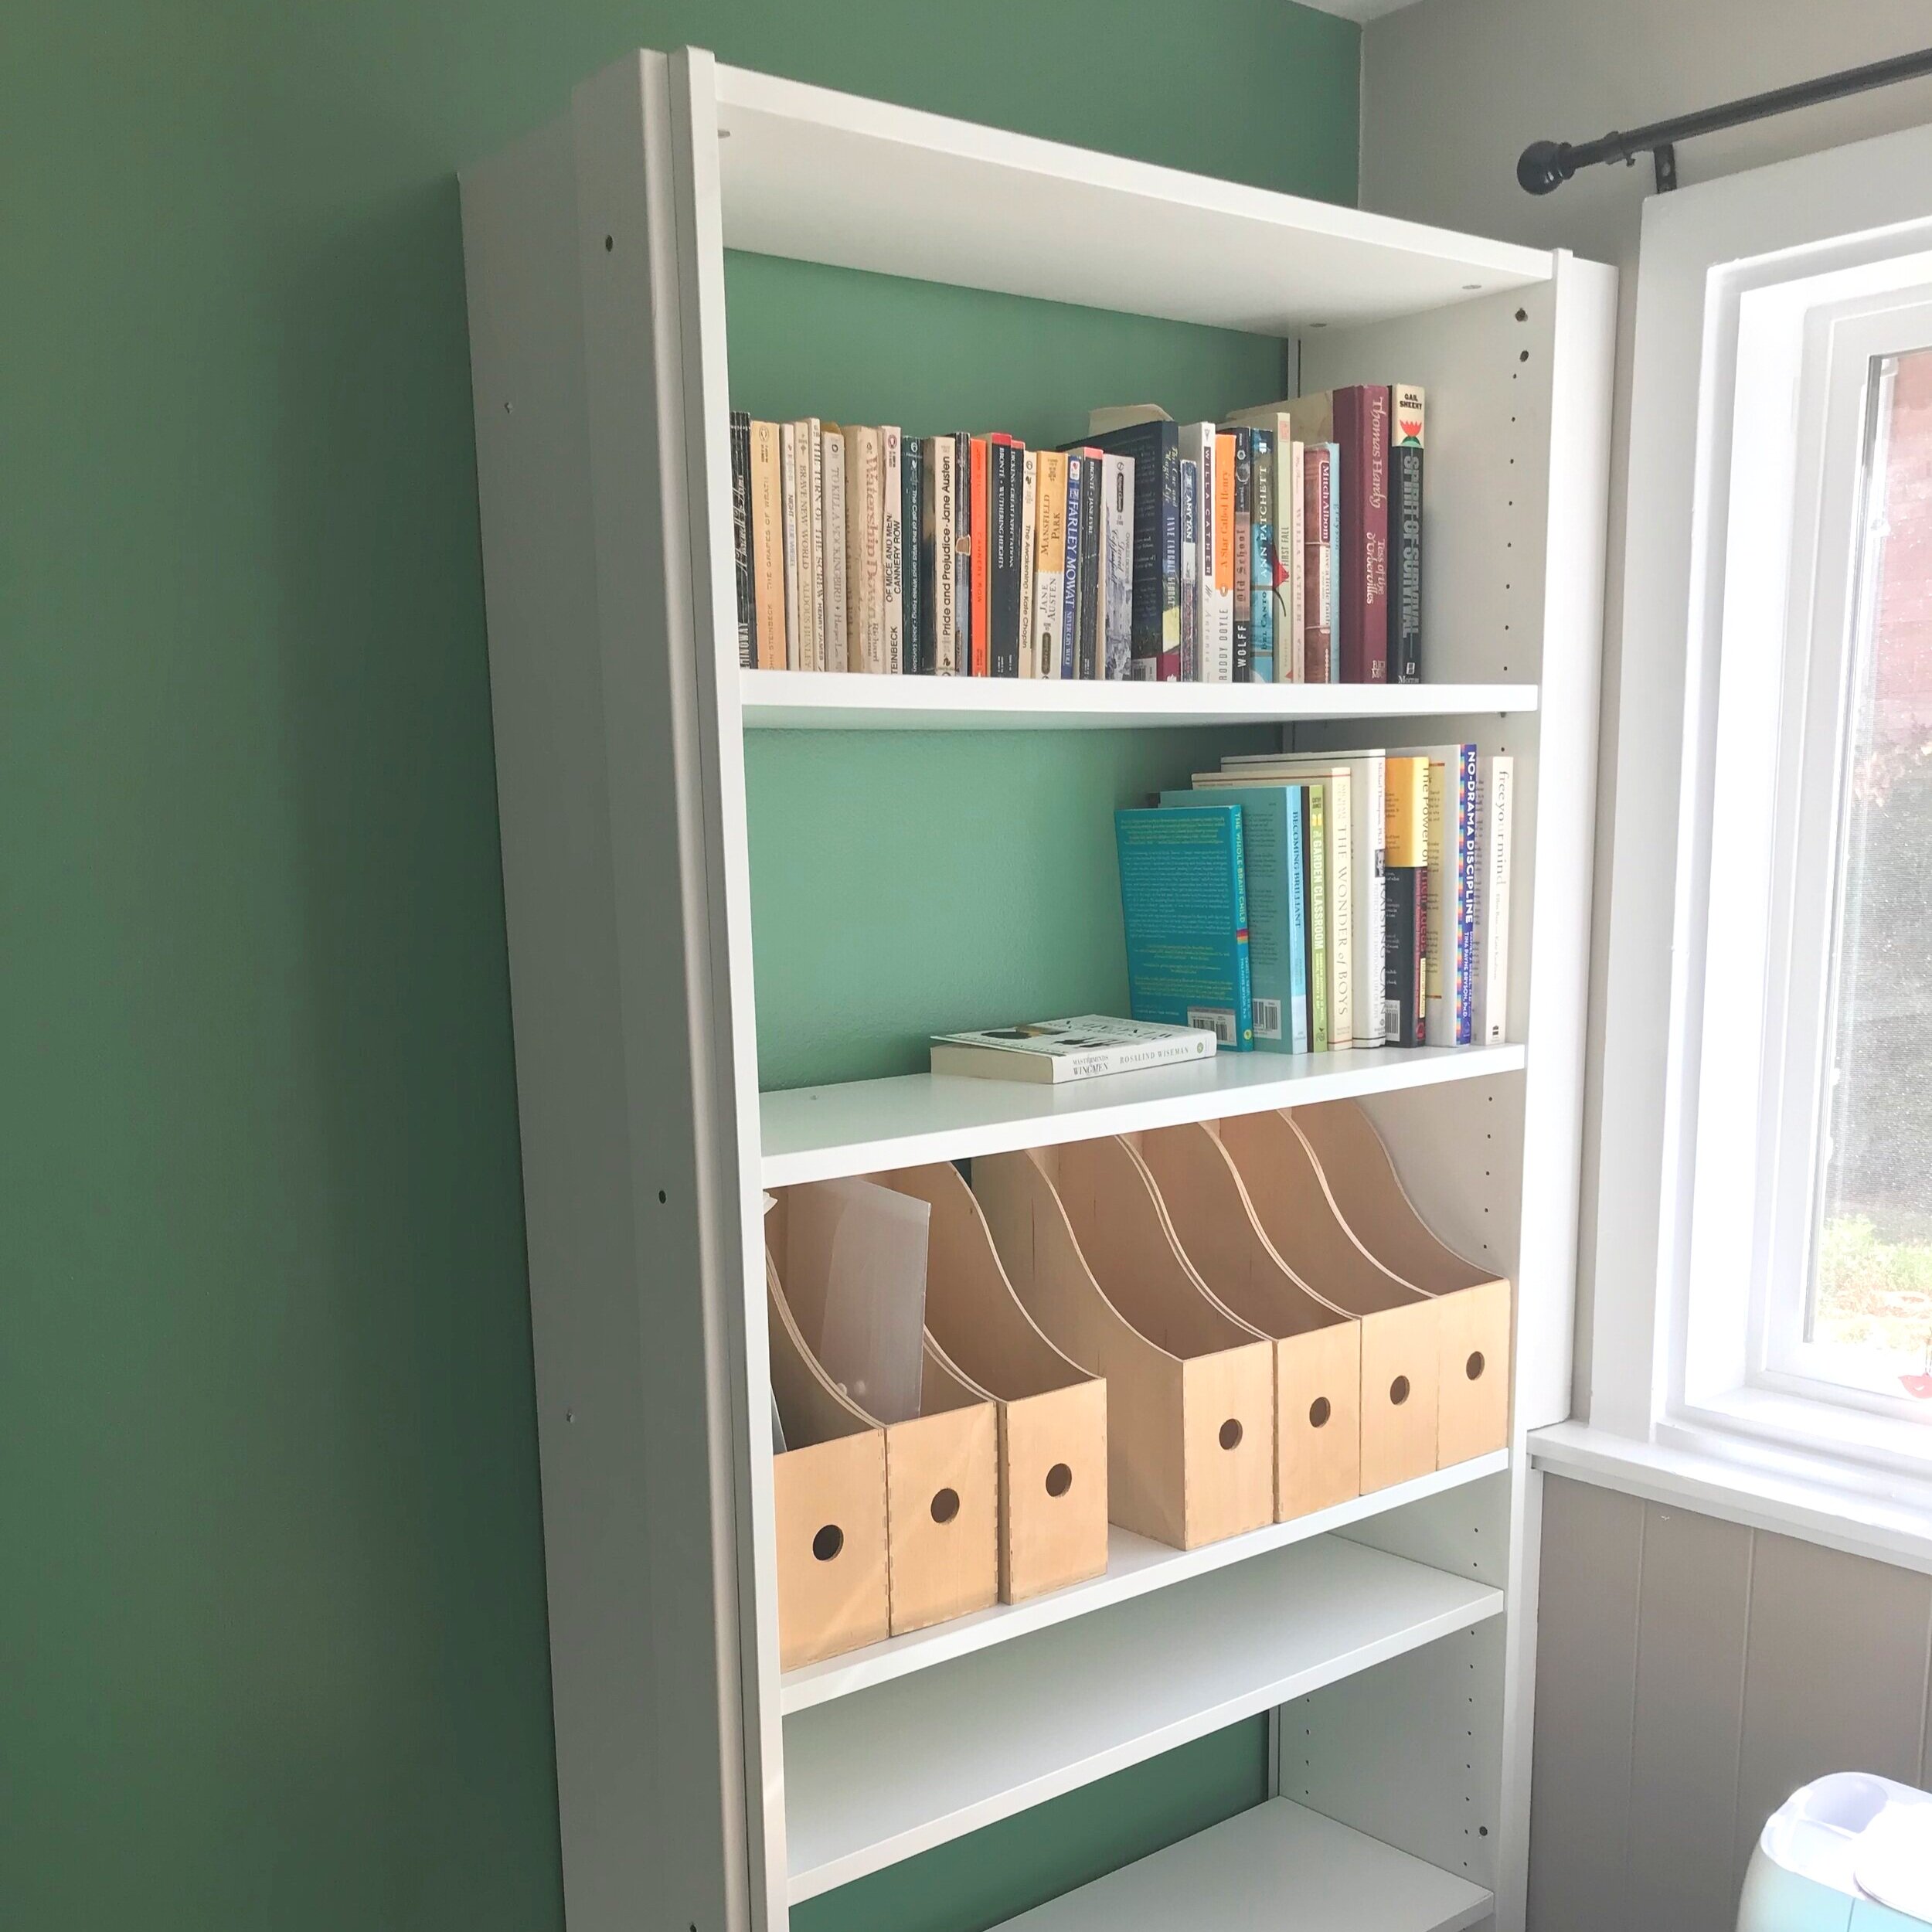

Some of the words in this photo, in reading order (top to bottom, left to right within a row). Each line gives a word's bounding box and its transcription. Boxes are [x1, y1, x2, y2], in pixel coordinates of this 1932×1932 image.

[1371, 396, 1386, 457] Thomas
[814, 470, 822, 502] TURN
[832, 467, 840, 484] TO
[941, 456, 951, 495] Austen
[1220, 471, 1230, 501] Henry
[1369, 458, 1387, 509] Hardy
[1403, 455, 1420, 518] SPIRIT
[832, 484, 841, 512] KILL
[866, 455, 879, 557] Watership
[942, 495, 951, 524] Jane
[1162, 484, 1172, 504] Life
[1259, 465, 1268, 542] PATCHETT
[832, 512, 841, 521] A
[912, 522, 918, 530] of
[1040, 494, 1050, 556] MANSFIELD
[1051, 512, 1060, 539] PARK
[1066, 500, 1079, 555] FARLEY
[1167, 517, 1175, 536] ANNE
[1220, 505, 1229, 538] Called
[1403, 519, 1420, 545] OF
[801, 529, 809, 570] WORLD
[815, 529, 823, 552] THE
[1220, 543, 1229, 559] Star
[1281, 527, 1290, 543] FALL
[1377, 538, 1386, 563] Tess
[832, 525, 842, 603] MOCKINGBIRD
[942, 529, 952, 581] Prejudice
[1022, 543, 1031, 589] Awakening
[1110, 529, 1120, 585] Copperfield
[1221, 560, 1229, 569] A
[1236, 529, 1247, 577] School
[1260, 543, 1268, 578] ANN
[1281, 546, 1290, 566] FIRST
[1366, 532, 1377, 605] d'Urbervilles
[1376, 563, 1386, 577] of
[815, 556, 824, 600] SCREW
[866, 560, 879, 619] Down
[942, 583, 951, 607] and
[1065, 556, 1077, 609] MOWAT
[1236, 580, 1247, 602] Old
[1377, 577, 1386, 595] the
[1403, 546, 1420, 638] SURVIVAL
[886, 590, 893, 603] OF
[1040, 584, 1049, 614] JANE
[1047, 577, 1056, 621] AUSTEN
[942, 607, 951, 636] Pride
[1219, 609, 1229, 641] DOYLE
[804, 625, 812, 668] HUXLEY
[1237, 624, 1247, 668] WOLFF
[1219, 648, 1229, 682] RODDY
[1466, 751, 1475, 836] NO-DRAMA
[1292, 811, 1301, 870] BECOMING
[1338, 825, 1347, 859] THE
[1422, 849, 1429, 864] of
[1313, 839, 1323, 883] GARDEN
[1465, 840, 1475, 924] DISCIPLINE
[1238, 896, 1247, 923] CHILD
[1294, 872, 1302, 928] BRILLIANT
[1338, 866, 1348, 947] WONDER
[1313, 888, 1324, 950] CLASSROOM
[1336, 952, 1348, 964] of
[1338, 971, 1348, 1015] BOYS
[1073, 1063, 1109, 1075] WINGMEN
[1120, 1051, 1156, 1064] ROSALIND
[1158, 1046, 1189, 1058] WISEMAN
